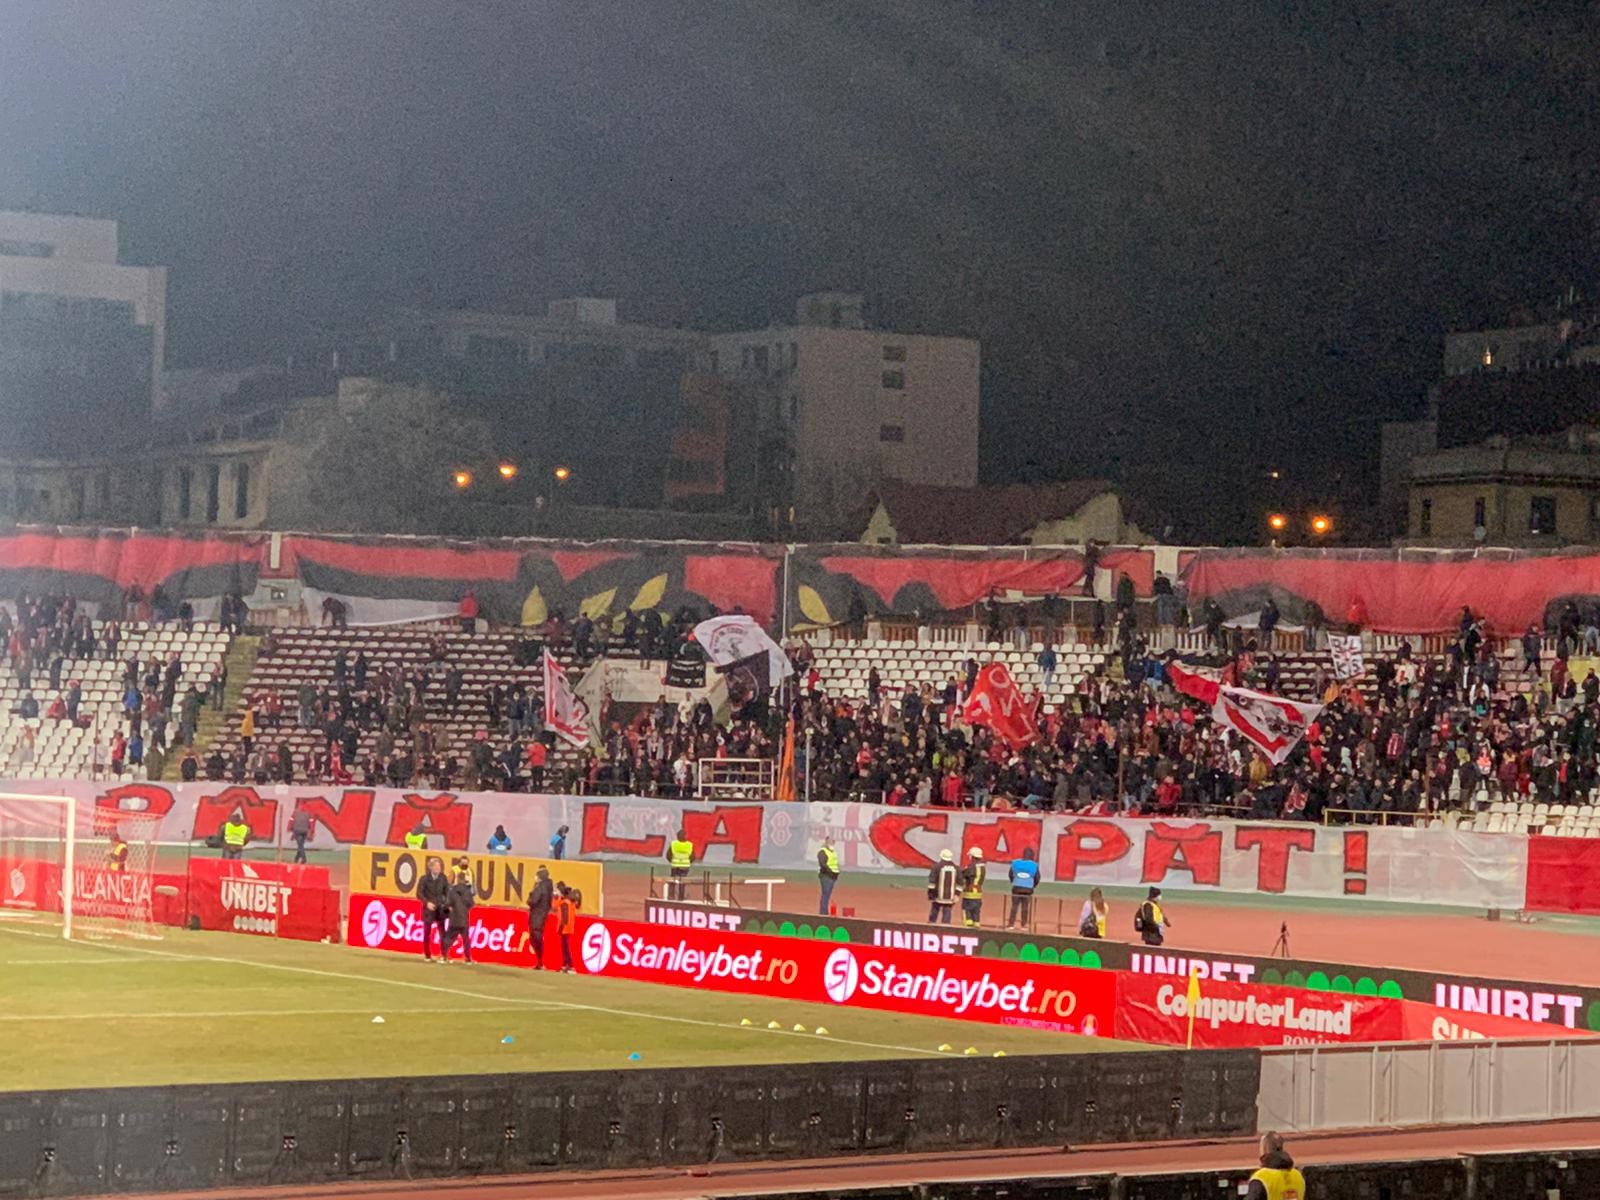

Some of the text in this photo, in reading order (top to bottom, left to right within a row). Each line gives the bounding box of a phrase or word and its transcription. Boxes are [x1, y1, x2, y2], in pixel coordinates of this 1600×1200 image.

[580, 802, 764, 863] LA
[221, 879, 292, 916] UNIBET
[612, 933, 799, 985] Stanleybet.ro
[861, 960, 1077, 1018] Stanleybet.ro
